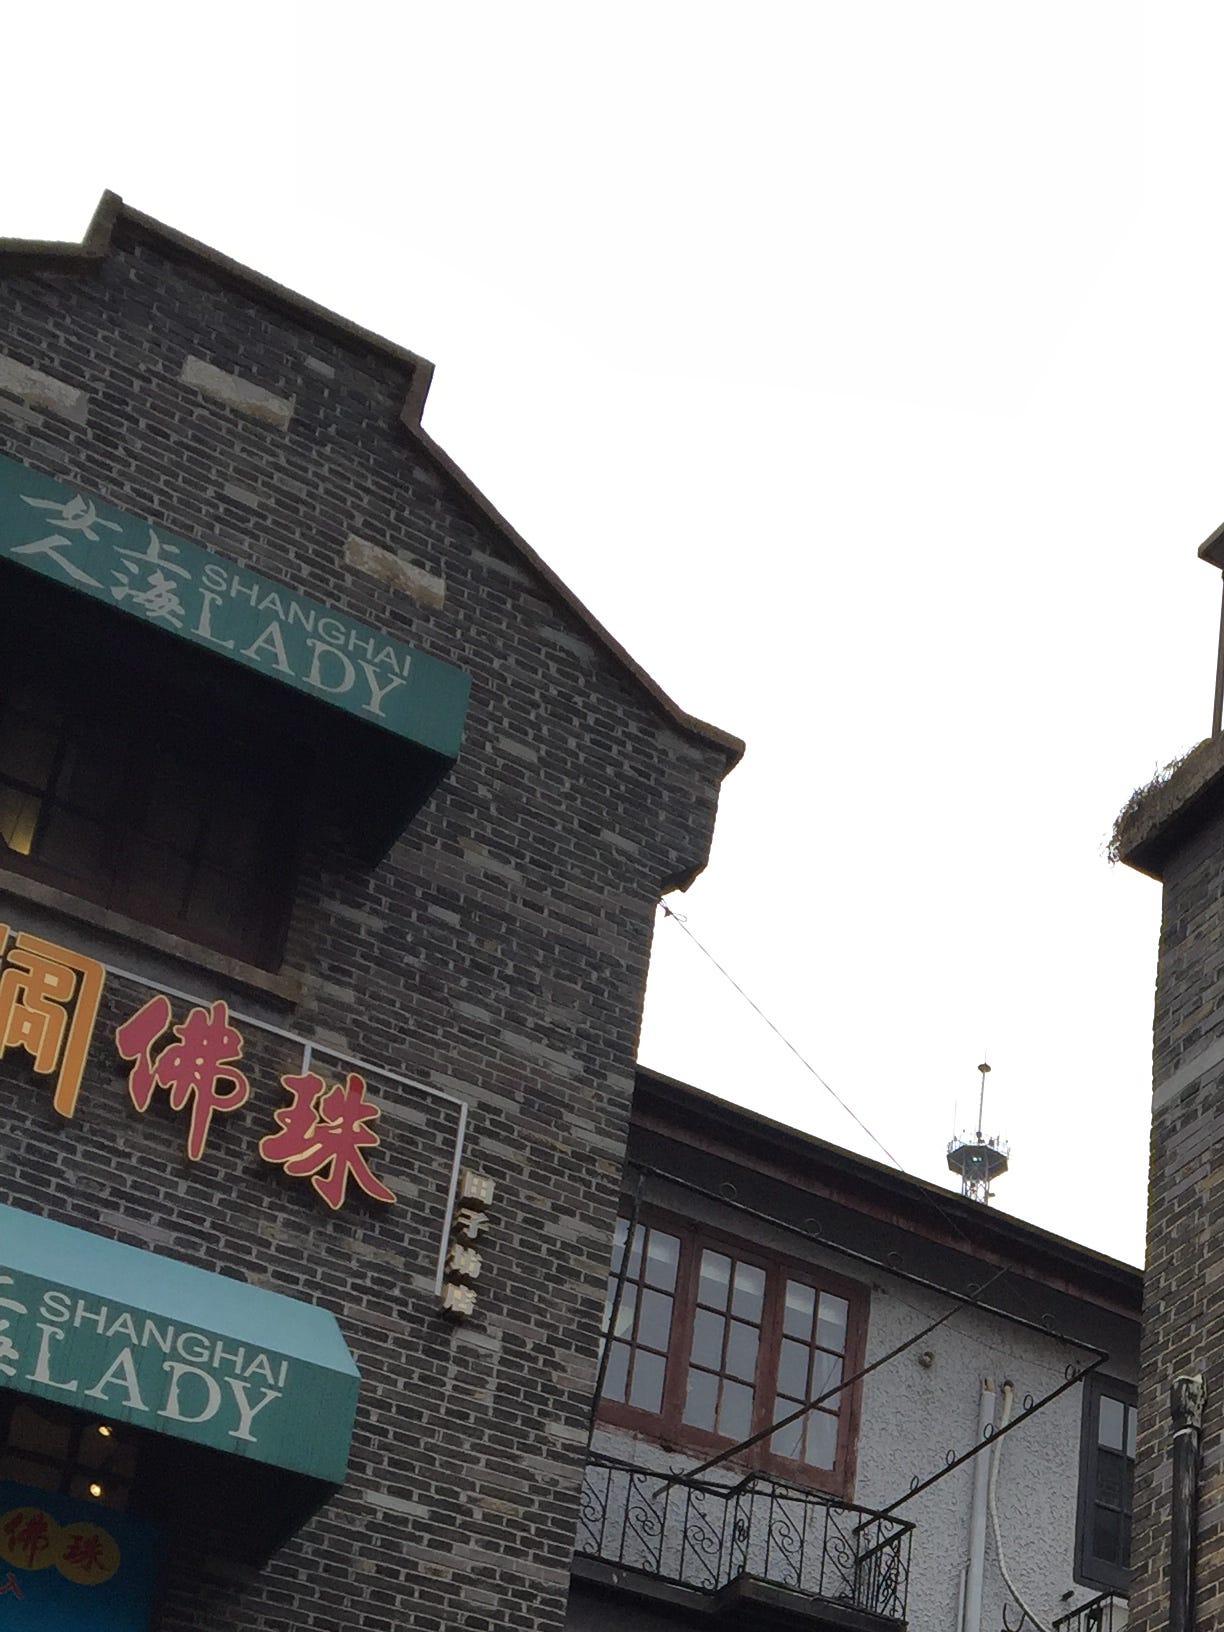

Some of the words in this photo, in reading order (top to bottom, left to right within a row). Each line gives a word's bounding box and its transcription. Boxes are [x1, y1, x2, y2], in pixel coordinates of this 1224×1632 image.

[191, 588, 407, 717] LADY
[201, 564, 412, 676] SHANGHAI
[25, 1322, 282, 1443] LADY
[40, 1291, 289, 1388] SHANGHAI
